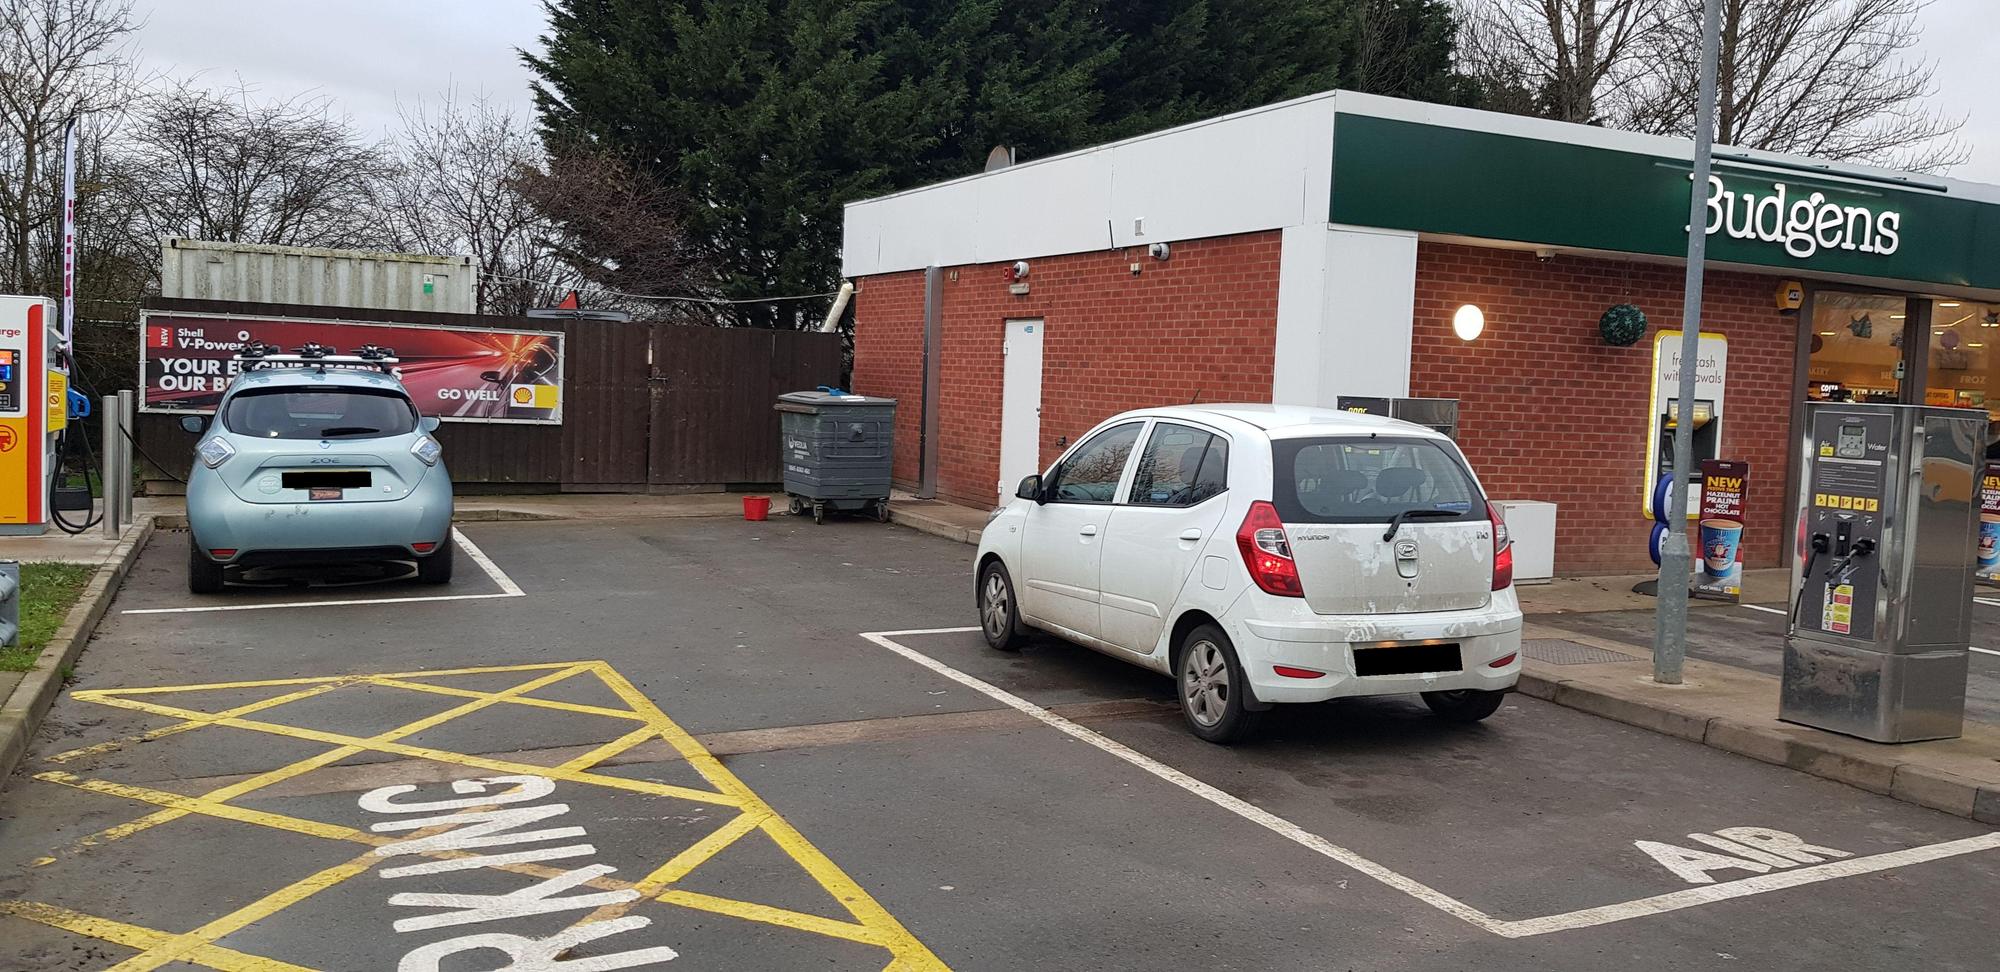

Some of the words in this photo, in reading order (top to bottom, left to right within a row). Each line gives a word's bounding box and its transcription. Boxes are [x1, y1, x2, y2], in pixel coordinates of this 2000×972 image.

[1685, 173, 1900, 258] Budgens
[161, 327, 169, 347] NEW
[178, 327, 204, 338] Shell
[178, 338, 245, 351] V-Power
[160, 358, 221, 375] YOUR
[1808, 368, 1830, 376] AKERY
[159, 375, 207, 391] OUR
[437, 388, 462, 400] GO
[464, 389, 500, 401] WELL
[1868, 443, 1887, 451] Water
[1707, 476, 1742, 489] NEW
[1706, 491, 1740, 499] HAZELNUT
[1706, 497, 1740, 506] PRALINE
[1703, 508, 1740, 516] CHOCOLATE
[1634, 826, 1856, 884] AIR
